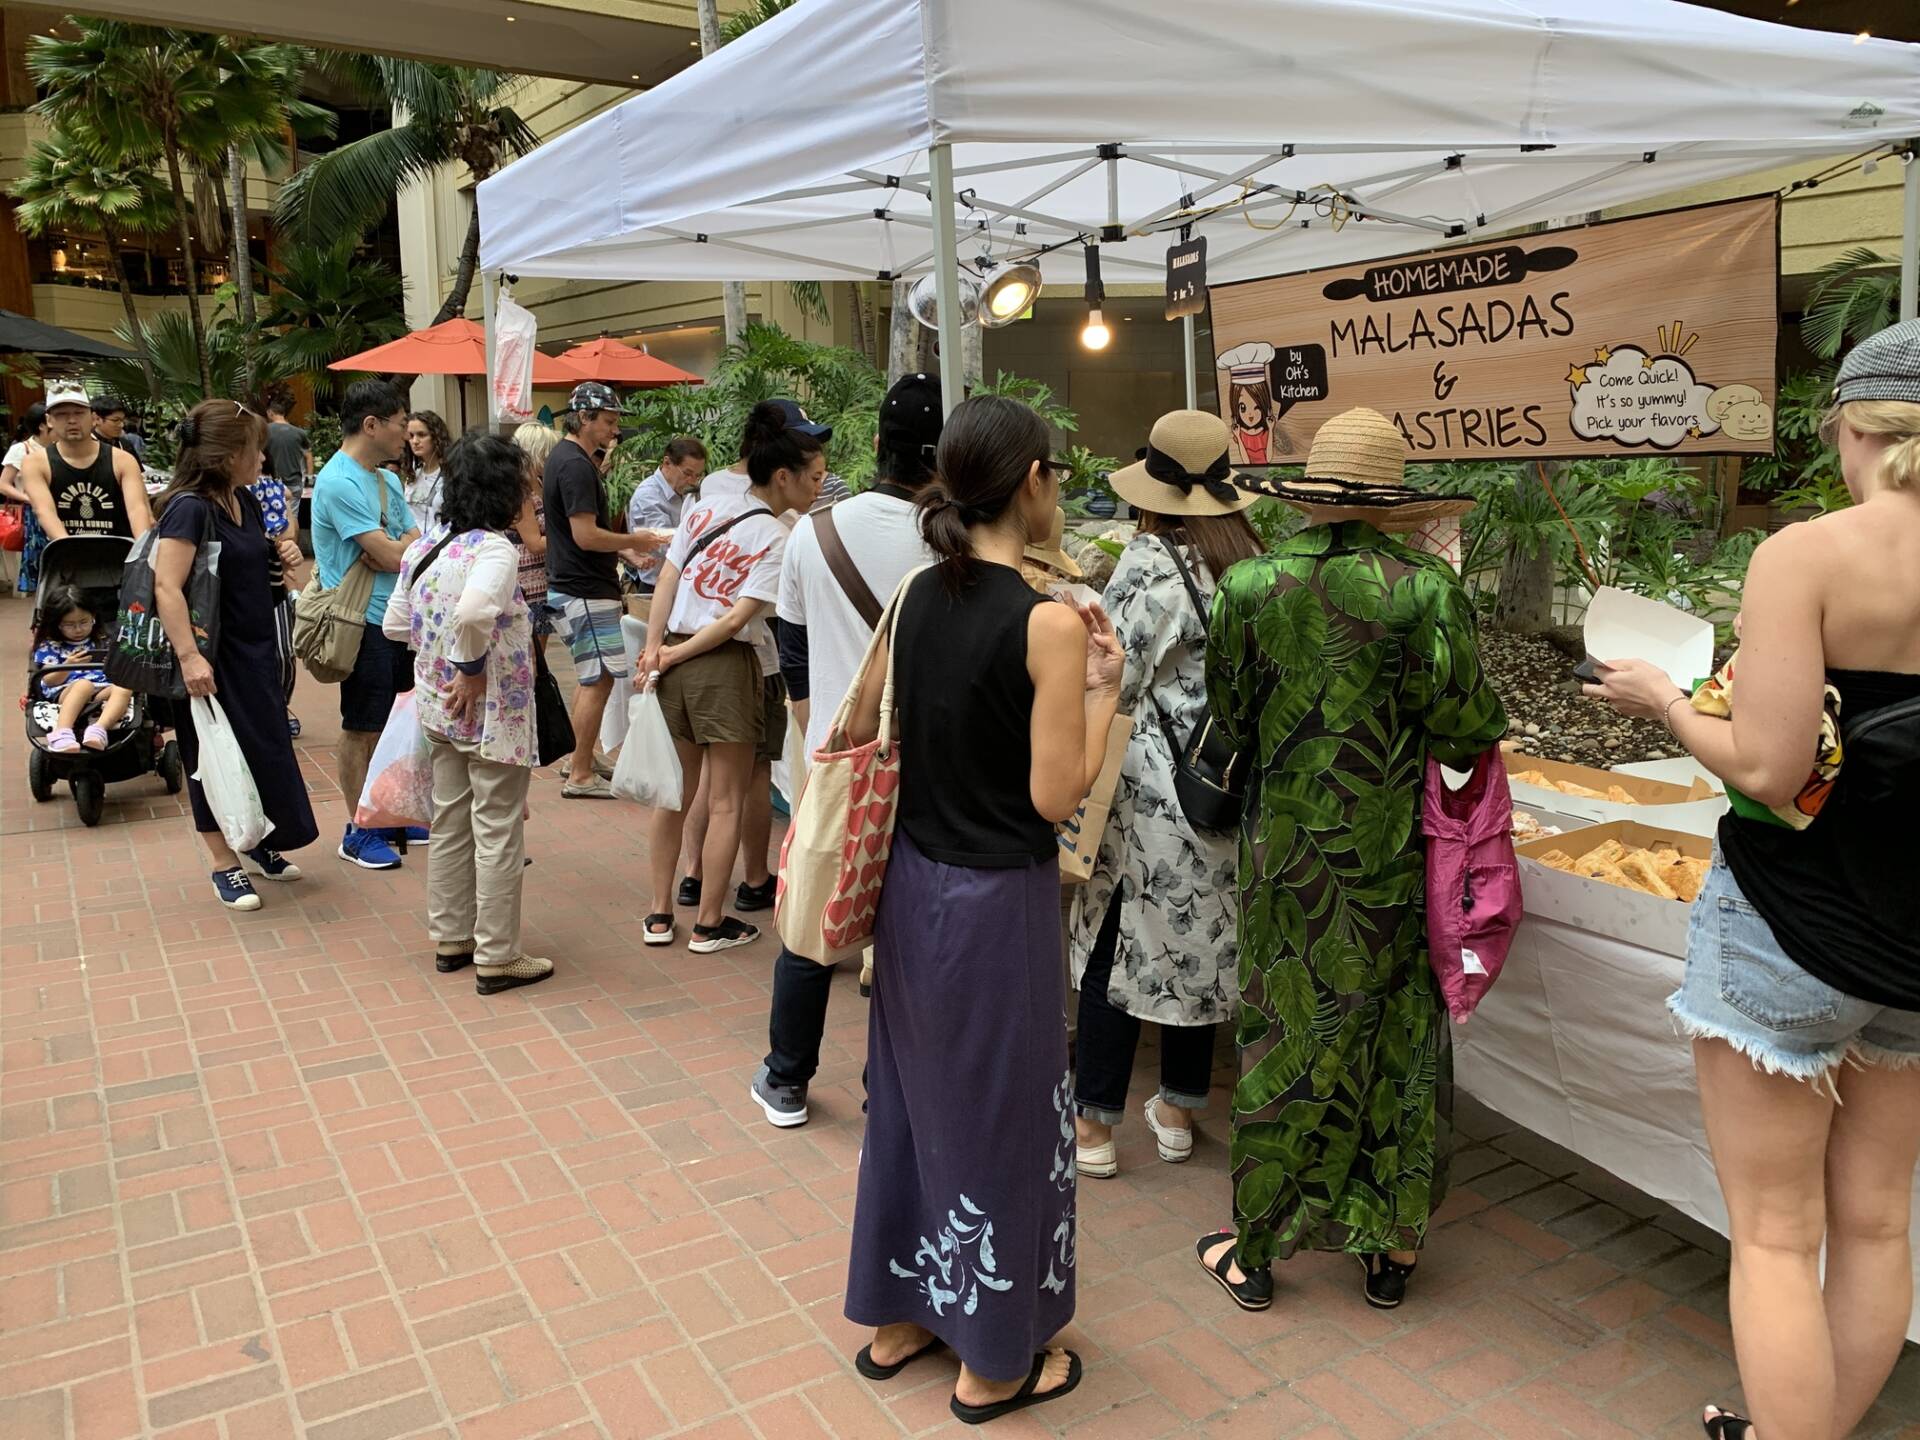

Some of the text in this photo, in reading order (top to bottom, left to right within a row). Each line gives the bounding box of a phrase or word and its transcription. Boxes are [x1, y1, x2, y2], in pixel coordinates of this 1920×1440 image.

[1374, 252, 1511, 298] HOMEMADE
[1330, 291, 1575, 358] MALASADAS
[1289, 348, 1302, 364] by
[1280, 383, 1319, 399] Kitchen
[1433, 360, 1459, 401] &
[1599, 368, 1679, 388] Come Quick!
[1596, 389, 1687, 410] It's so yummy!
[1393, 405, 1548, 450] ASTRIES
[1586, 415, 1614, 430] Pick
[1618, 417, 1646, 432] your
[58, 482, 114, 510] HONOLULU
[117, 609, 172, 653] ALO
